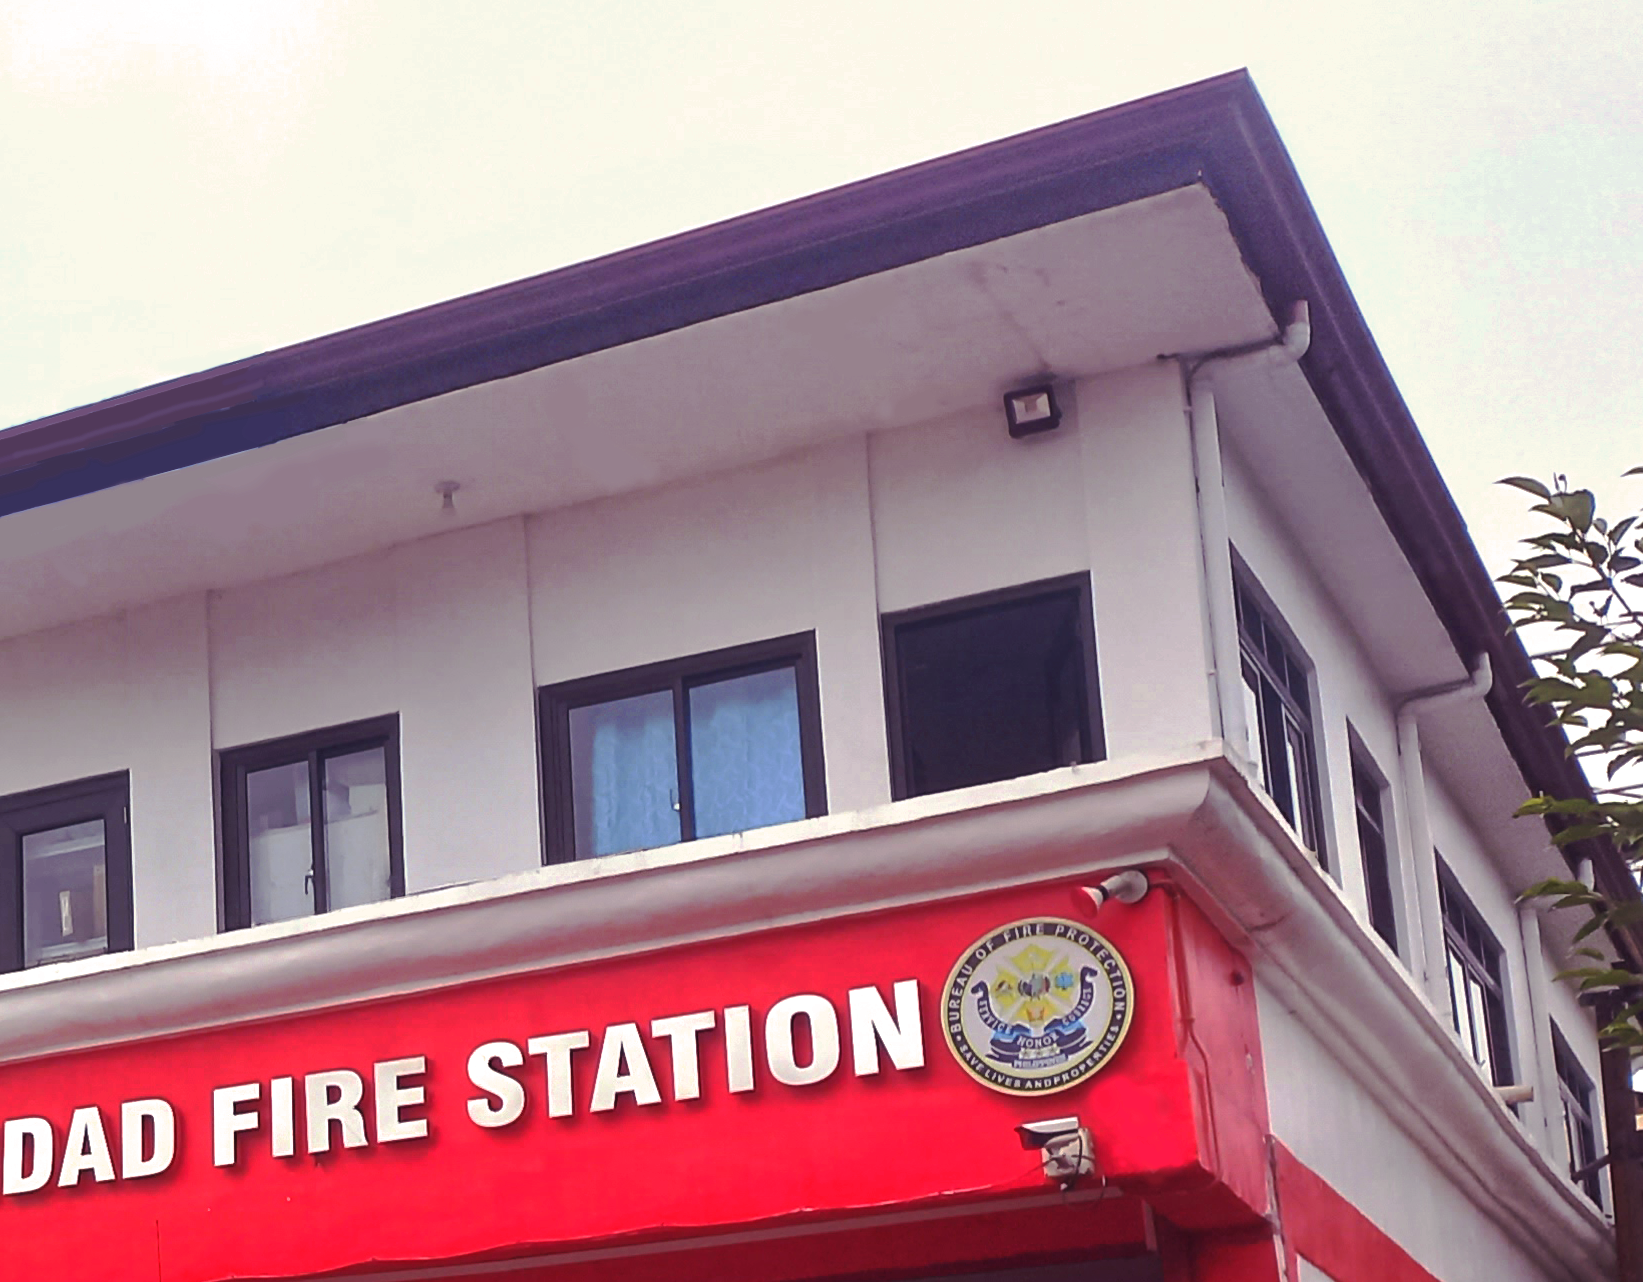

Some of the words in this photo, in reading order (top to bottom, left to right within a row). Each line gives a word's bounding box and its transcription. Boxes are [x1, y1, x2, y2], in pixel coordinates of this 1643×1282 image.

[949, 965, 973, 1033] BUREAU
[976, 942, 995, 960] OF
[1003, 923, 1044, 942] FIRE
[1055, 925, 1126, 1011] PROTECTION
[213, 1056, 428, 1166] FIRE
[466, 979, 925, 1129] STATION
[960, 1045, 982, 1073] SAVE
[984, 1068, 1021, 1088] LIVES
